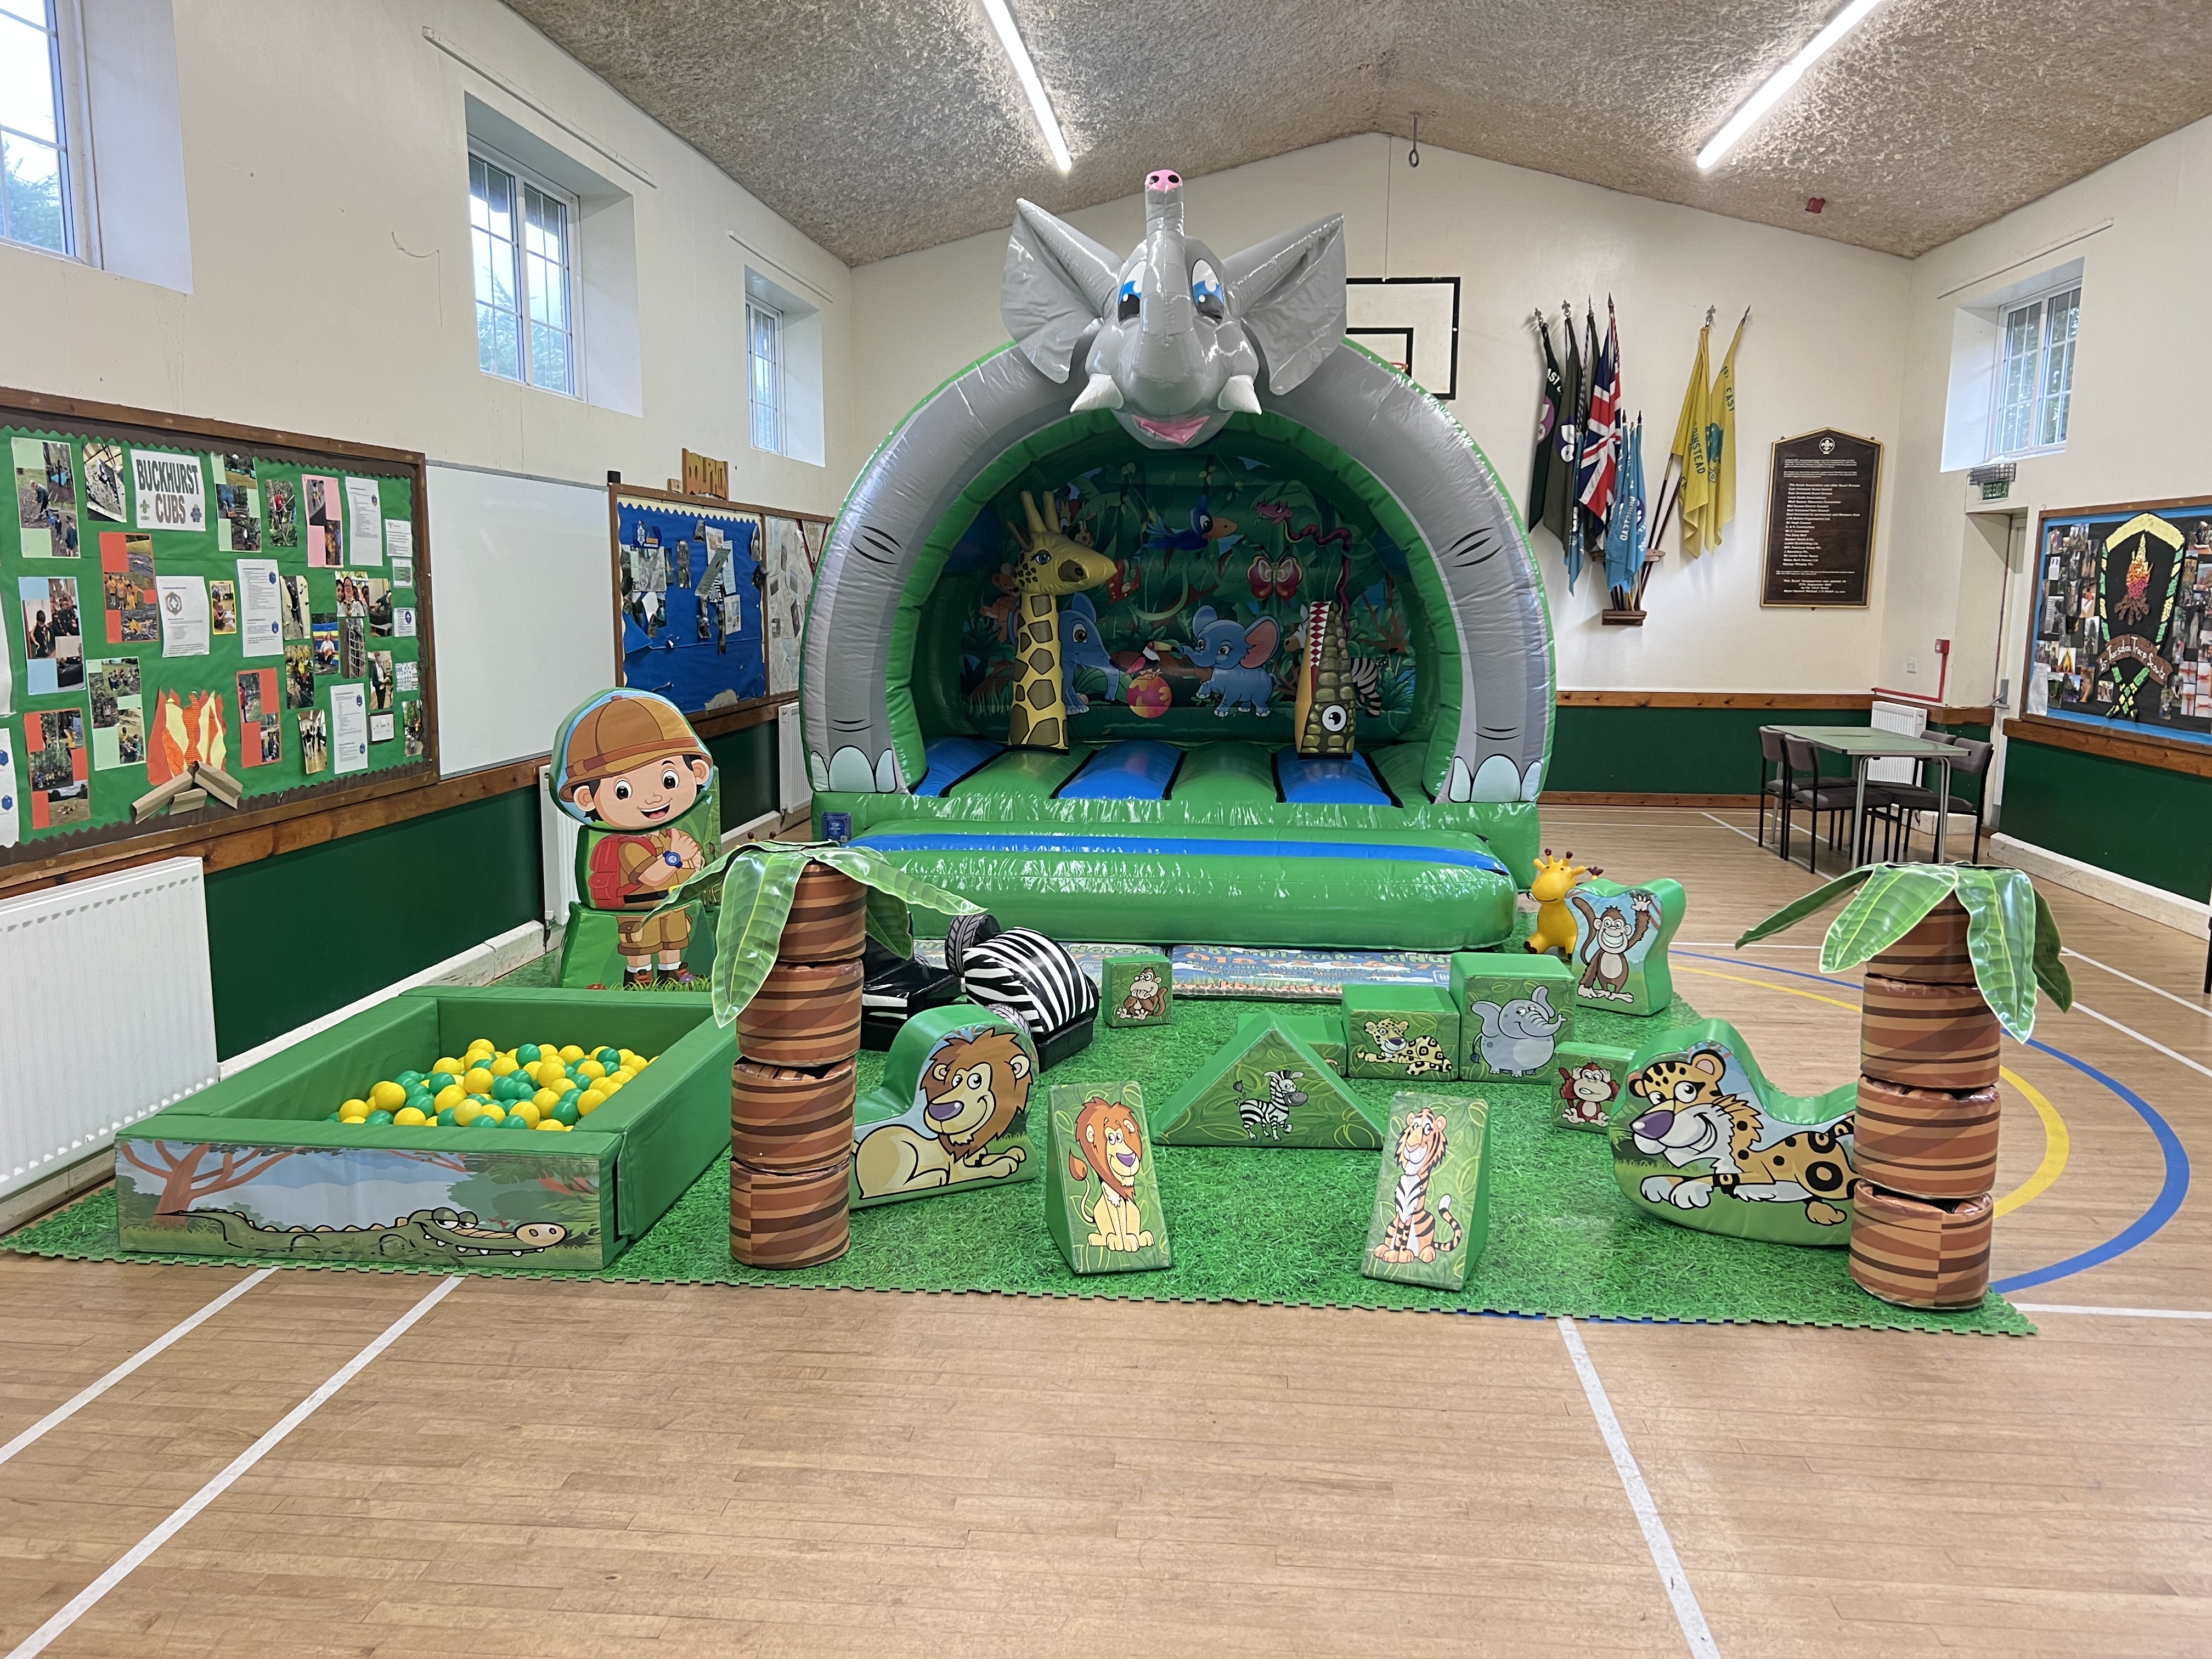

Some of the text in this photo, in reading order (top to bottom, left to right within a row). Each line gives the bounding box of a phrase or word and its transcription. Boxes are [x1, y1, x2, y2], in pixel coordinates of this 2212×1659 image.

[136, 459, 199, 495] BUCKHURST
[686, 450, 728, 500] DOLPHIN
[155, 493, 186, 524] CUBS
